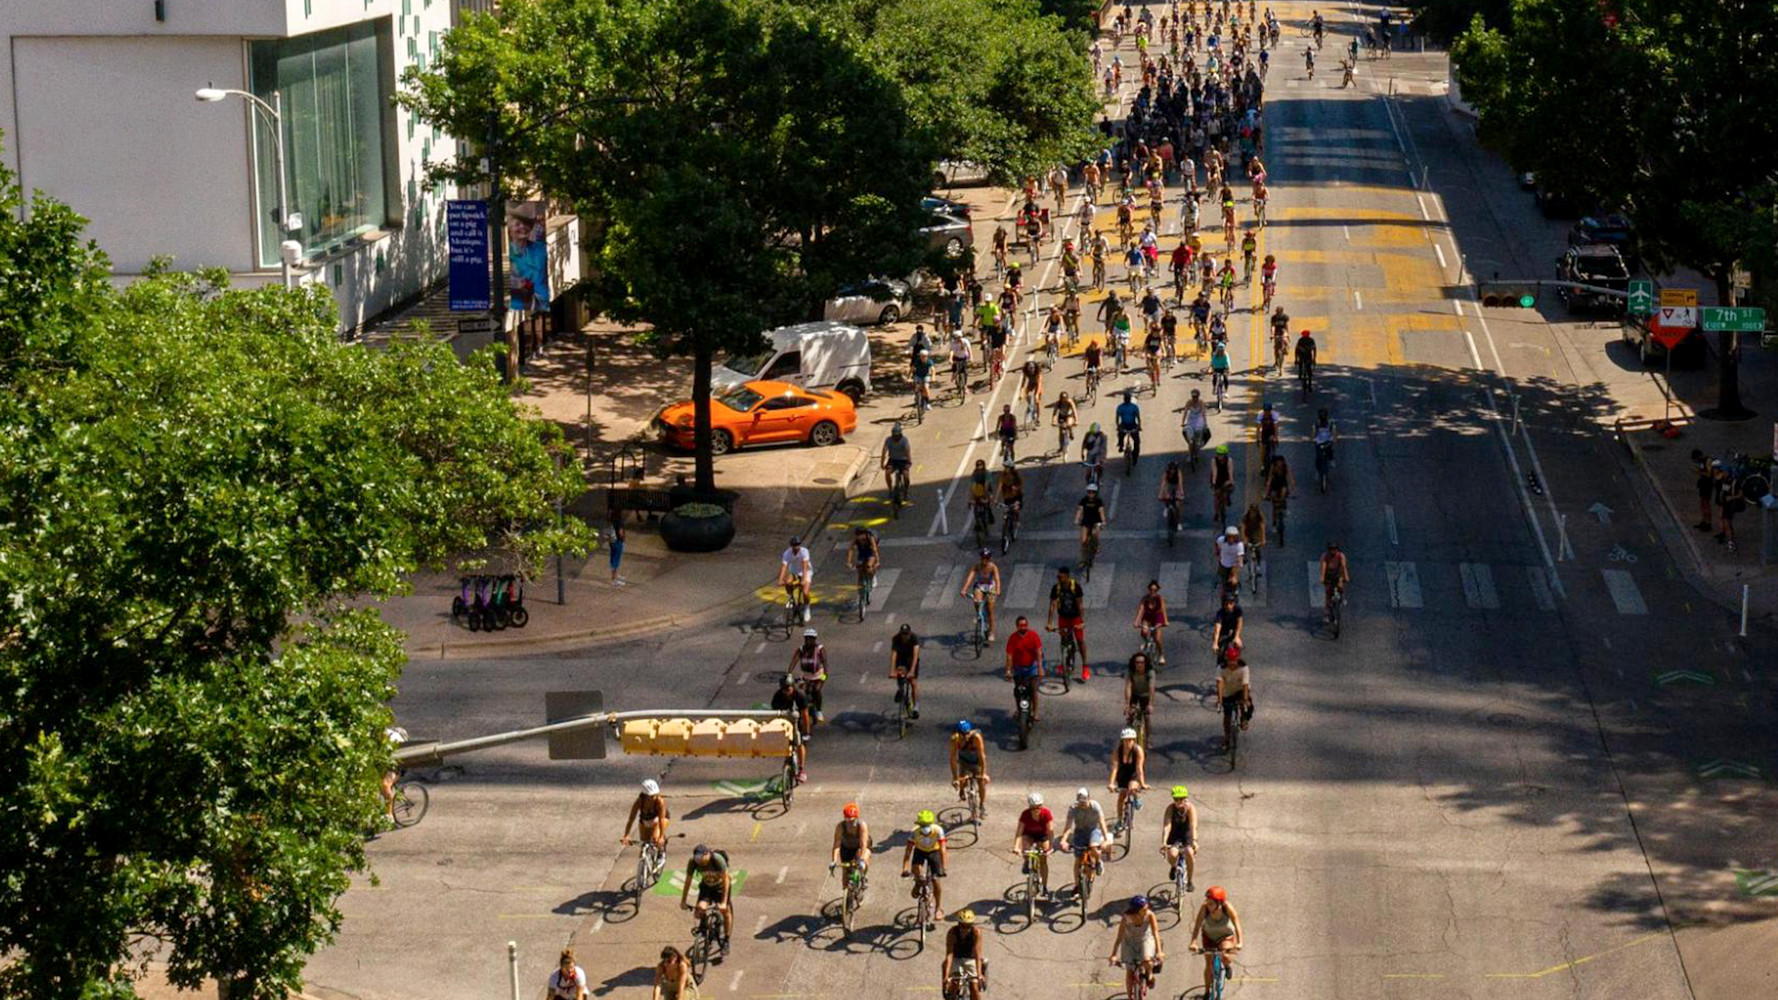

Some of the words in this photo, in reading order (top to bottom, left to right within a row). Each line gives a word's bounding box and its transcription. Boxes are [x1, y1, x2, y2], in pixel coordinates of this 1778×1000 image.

[465, 220, 477, 229] pig
[1716, 309, 1737, 322] 7th
[1742, 310, 1753, 318] ST
